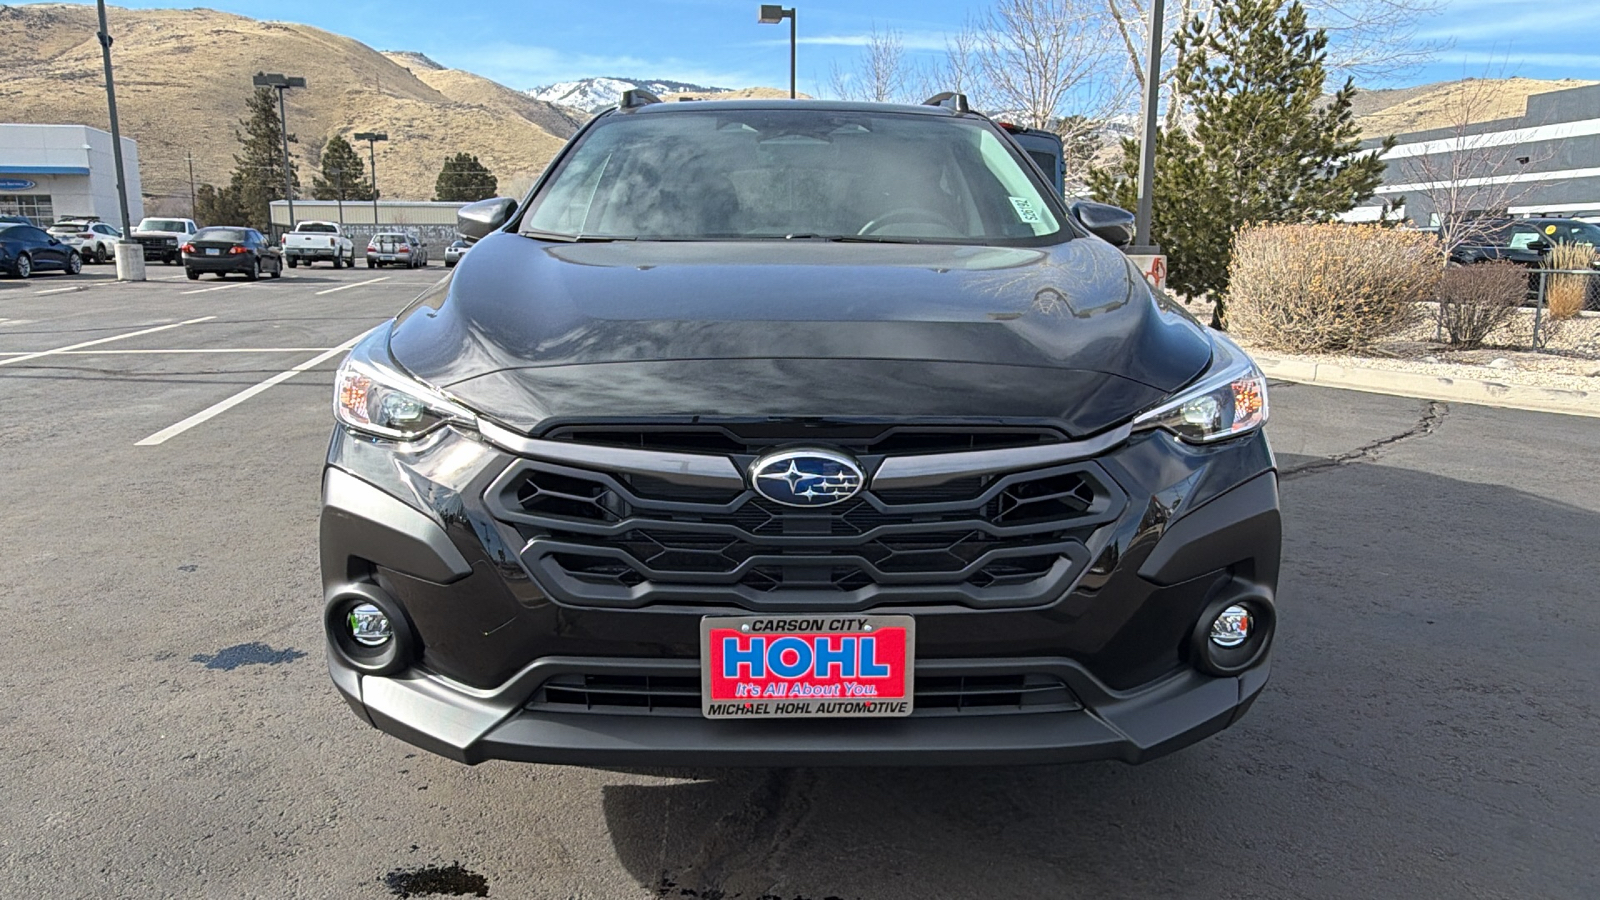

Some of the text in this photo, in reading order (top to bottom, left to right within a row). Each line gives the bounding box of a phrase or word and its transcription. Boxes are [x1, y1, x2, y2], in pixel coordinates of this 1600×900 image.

[751, 618, 868, 632] CARSON CITY
[723, 636, 891, 678] HOHL
[735, 681, 878, 697] It's All About You.
[708, 701, 908, 716] MICHAEL HOHL AUTOMOTIVE
